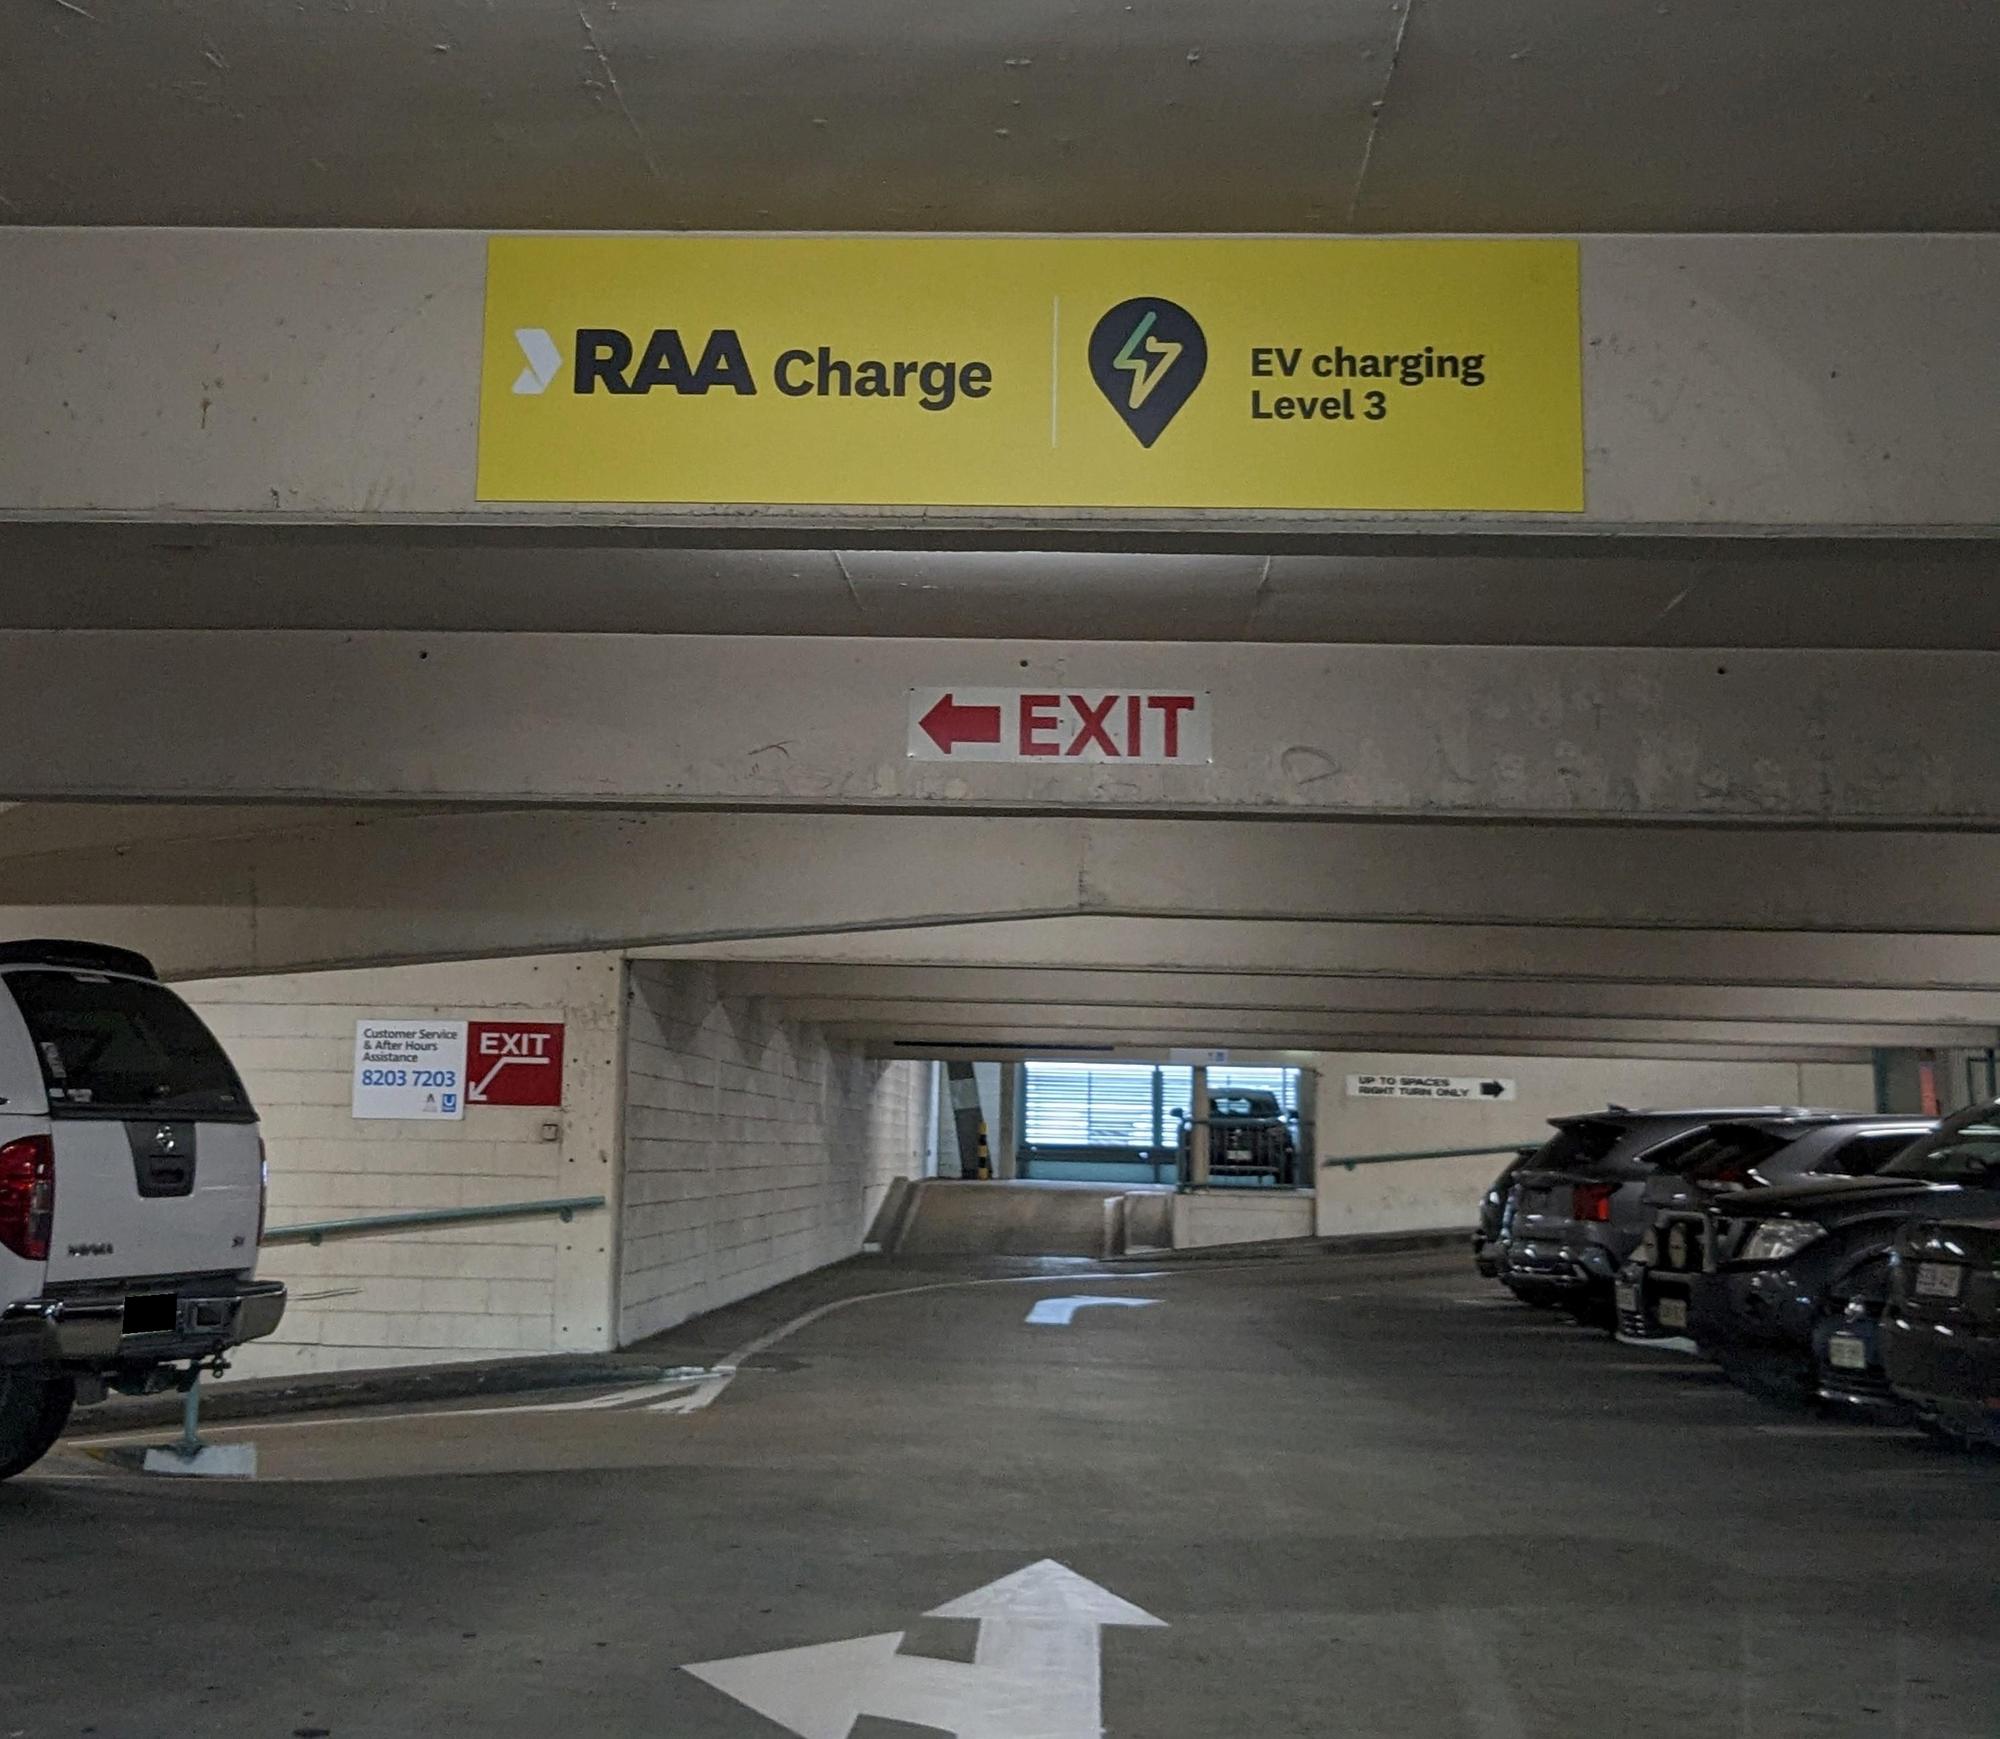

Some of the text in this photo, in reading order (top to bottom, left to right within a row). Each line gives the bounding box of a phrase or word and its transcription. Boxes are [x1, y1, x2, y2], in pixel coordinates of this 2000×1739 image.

[573, 328, 993, 412] RAA Charge
[1250, 346, 1486, 388] EV charging
[1250, 388, 1388, 421] Level 3
[1018, 694, 1195, 757] EXIT
[363, 1028, 458, 1040] Customer Service
[363, 1040, 438, 1051] & After Hours
[480, 1032, 550, 1055] EXIT
[362, 1052, 418, 1062] Assistance
[362, 1069, 456, 1087] 8203 7203
[1358, 1076, 1450, 1087] UP TO SPACES
[1358, 1086, 1470, 1097] RIGHT TURN ONLY
